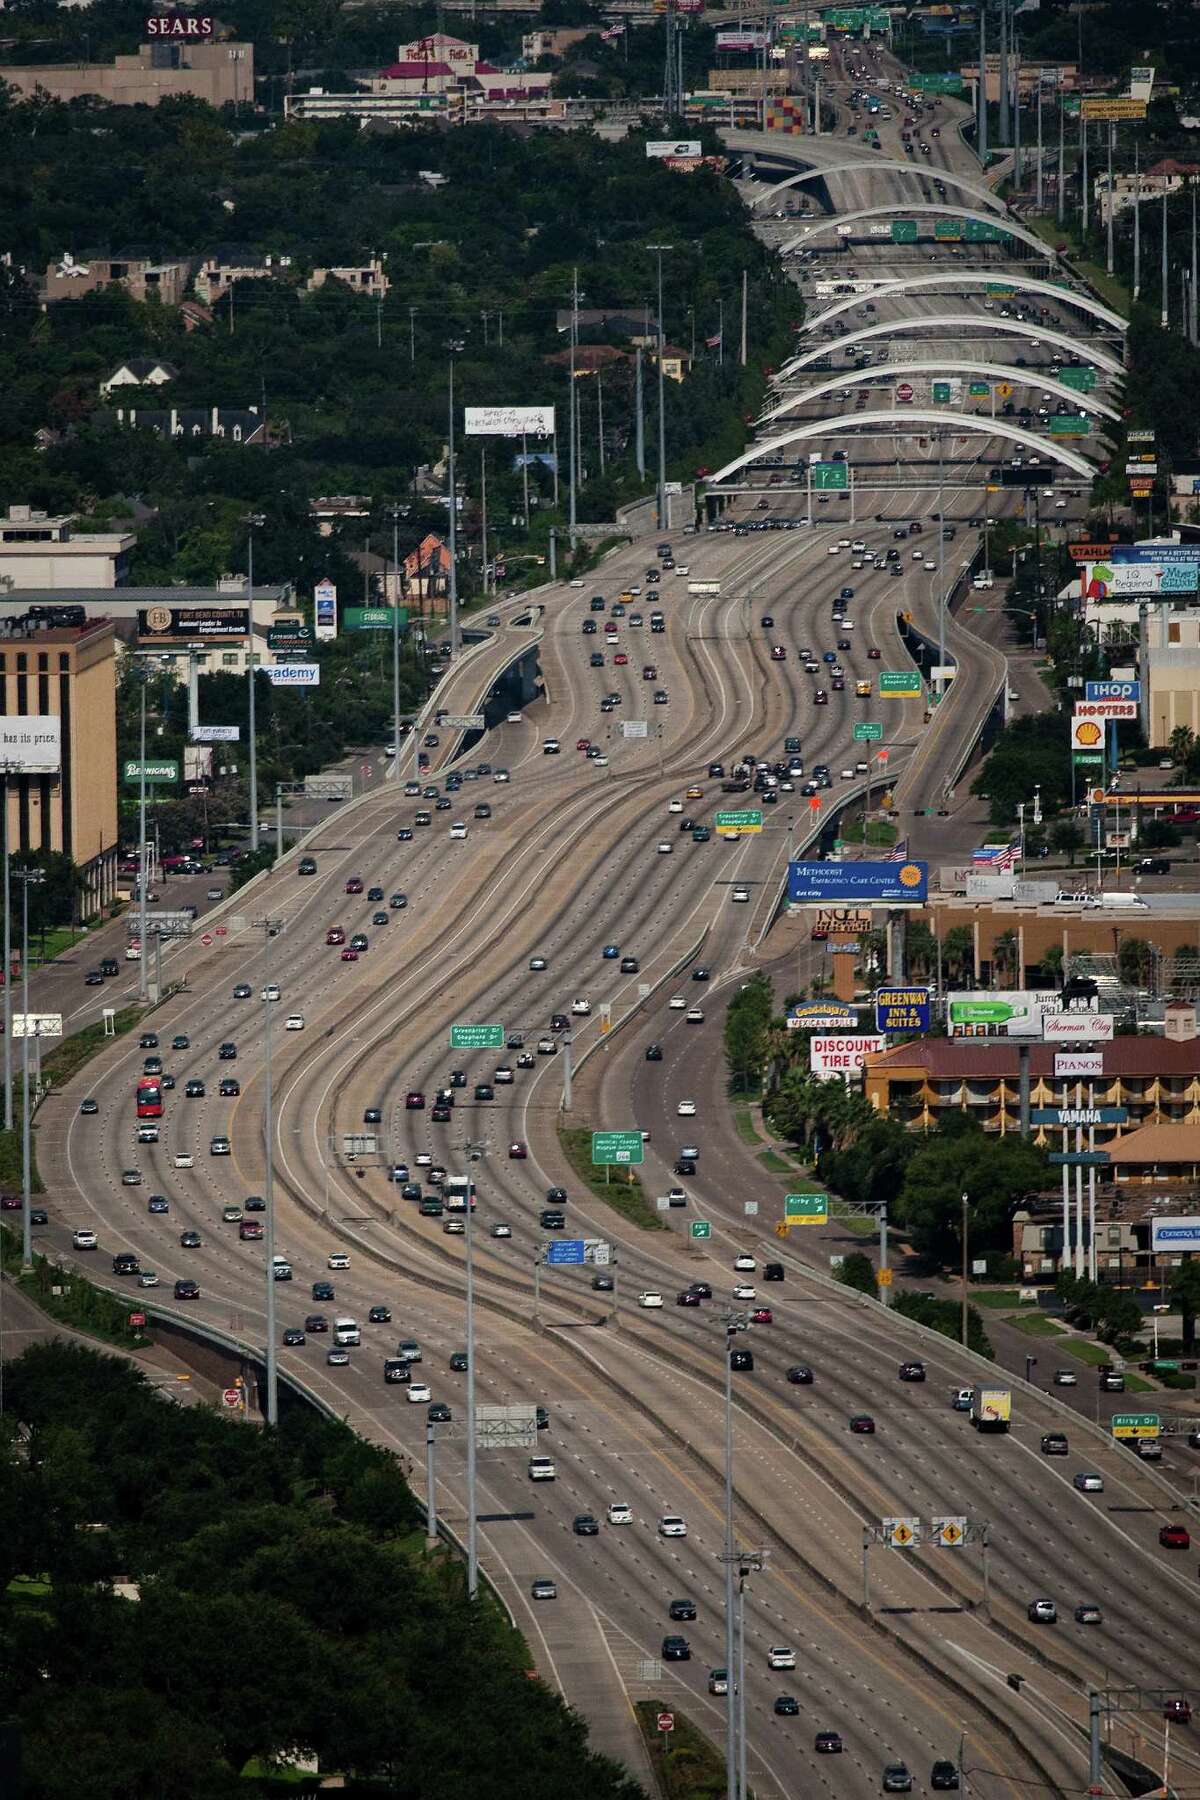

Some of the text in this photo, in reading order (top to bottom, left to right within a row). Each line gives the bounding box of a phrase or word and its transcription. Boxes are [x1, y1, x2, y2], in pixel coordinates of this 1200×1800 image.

[147, 17, 212, 34] SEARS
[1115, 579, 1153, 591] Required
[195, 610, 211, 618] BEND
[266, 668, 316, 681] cademy
[1094, 684, 1133, 697] IHOP
[1078, 705, 1134, 716] HOOTERS
[20, 733, 31, 743] its
[796, 867, 843, 876] METHODIST
[850, 876, 868, 884] CARE
[870, 876, 896, 885] CENTER
[879, 992, 927, 1006] GREENWAY
[889, 1008, 918, 1018] INN &
[1040, 1005, 1055, 1015] Big
[886, 1018, 921, 1027] SUITES
[1046, 1017, 1111, 1036] Sherman Clay
[814, 1040, 880, 1052] DISCOUNT
[821, 1055, 850, 1067] TIRE
[1056, 1060, 1103, 1070] PIANOS
[1058, 1110, 1101, 1123] YAMAHA
